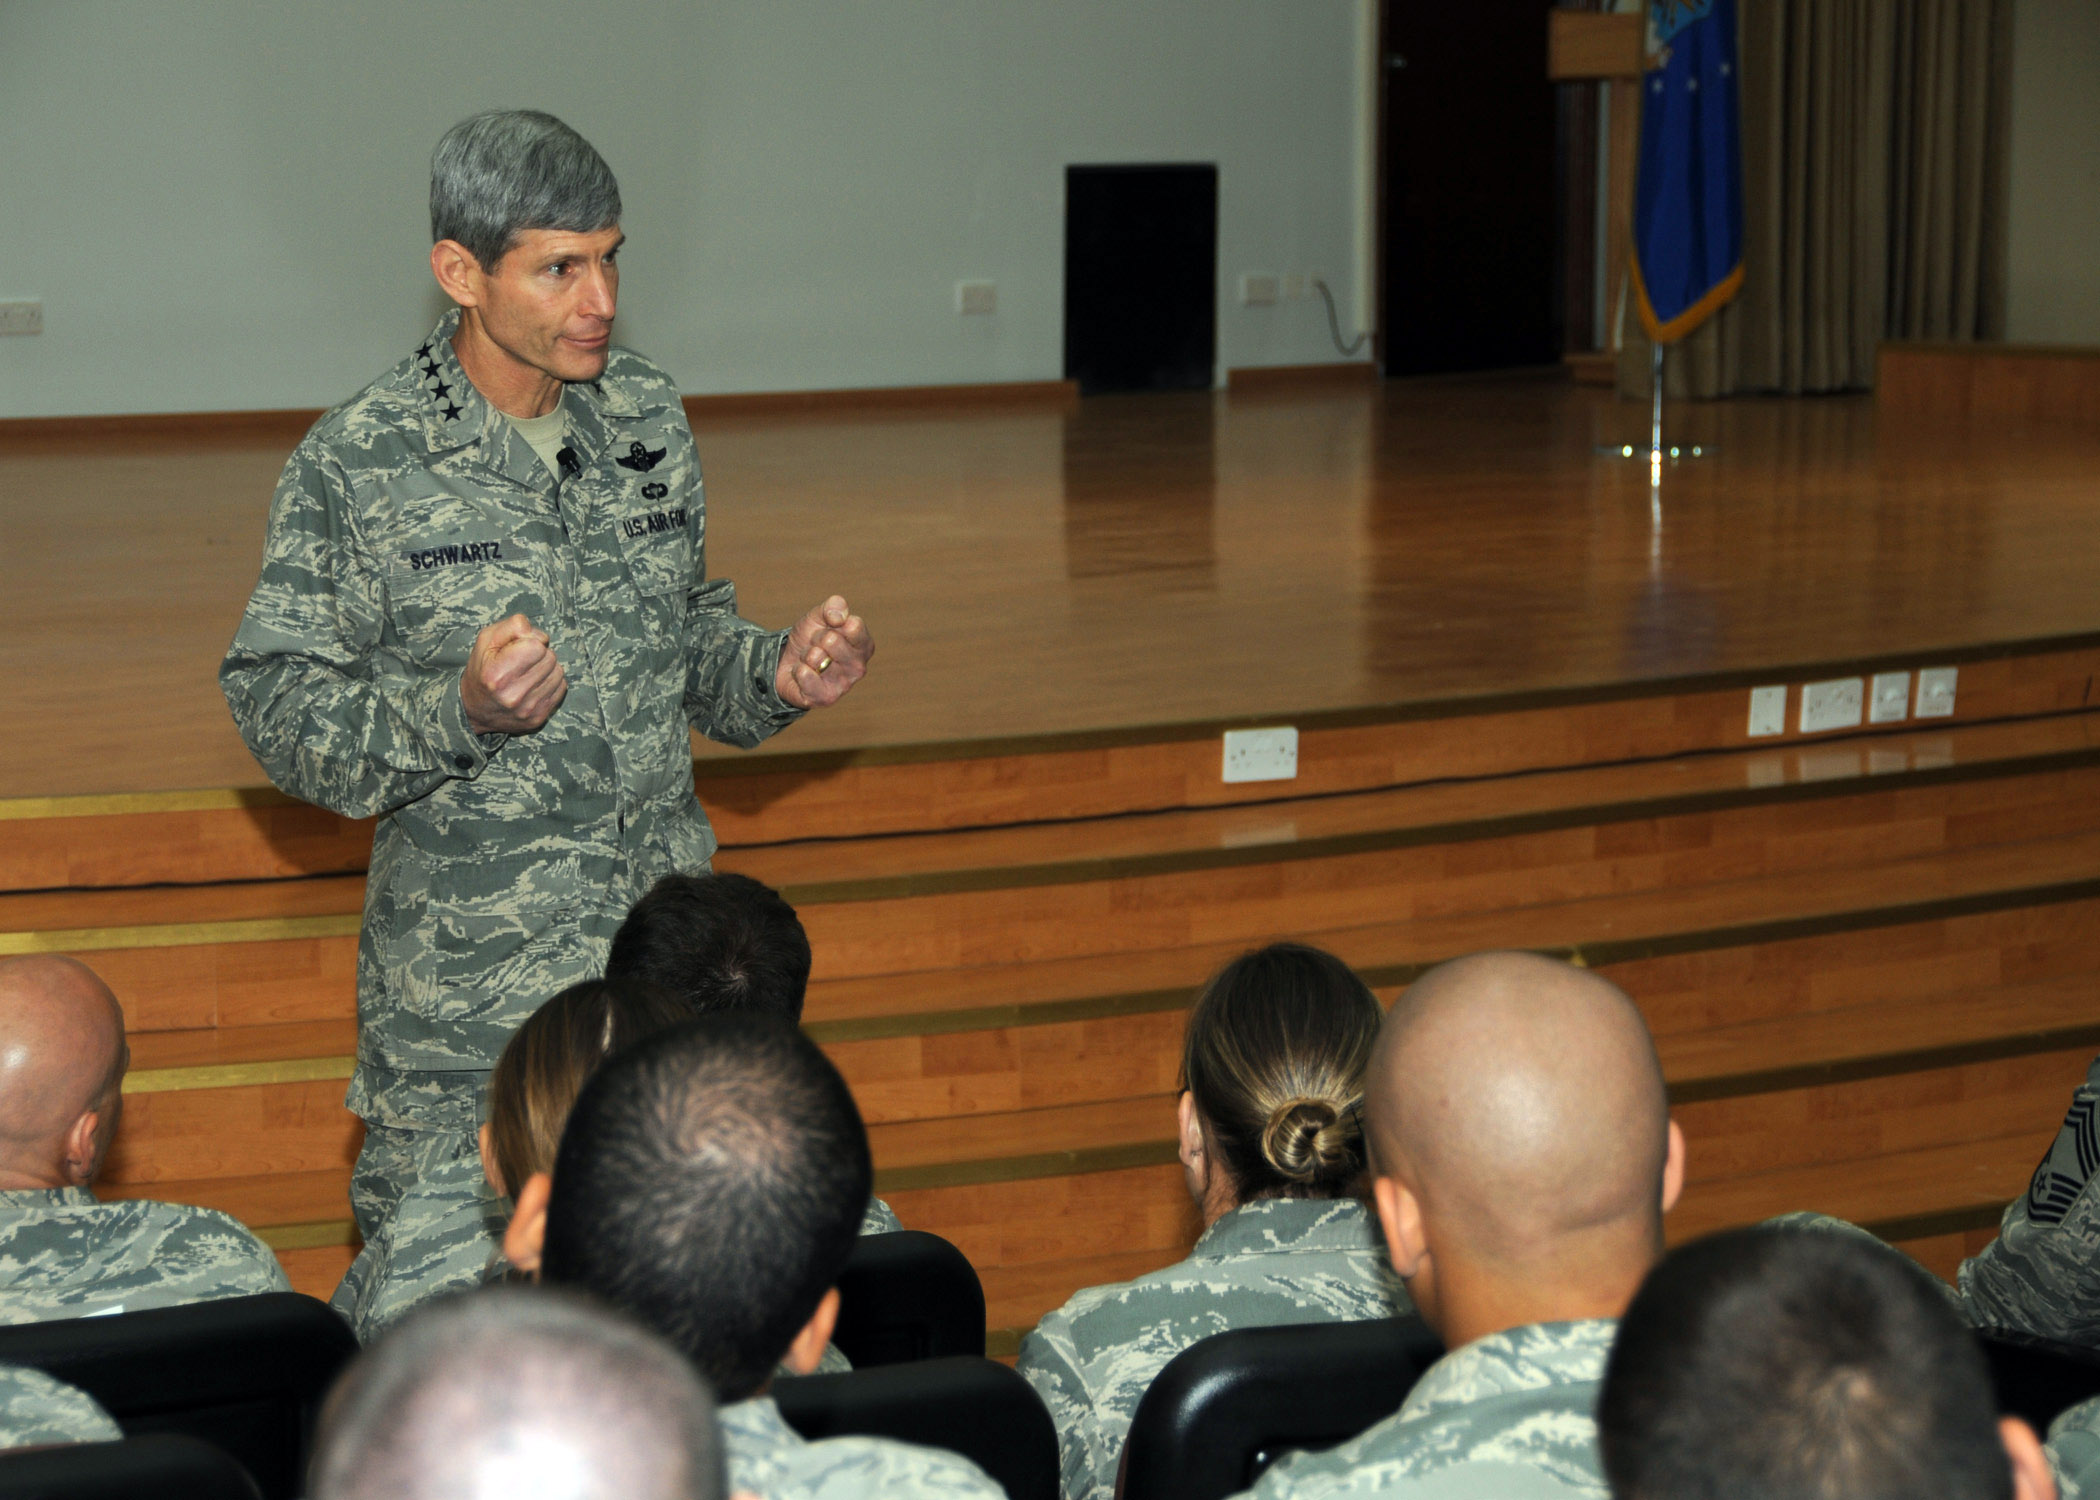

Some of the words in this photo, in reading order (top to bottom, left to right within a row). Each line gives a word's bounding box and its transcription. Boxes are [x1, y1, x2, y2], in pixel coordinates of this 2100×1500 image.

[623, 519, 647, 538] U.S.
[647, 513, 670, 533] AIR
[410, 542, 502, 570] SCHWARTZ
